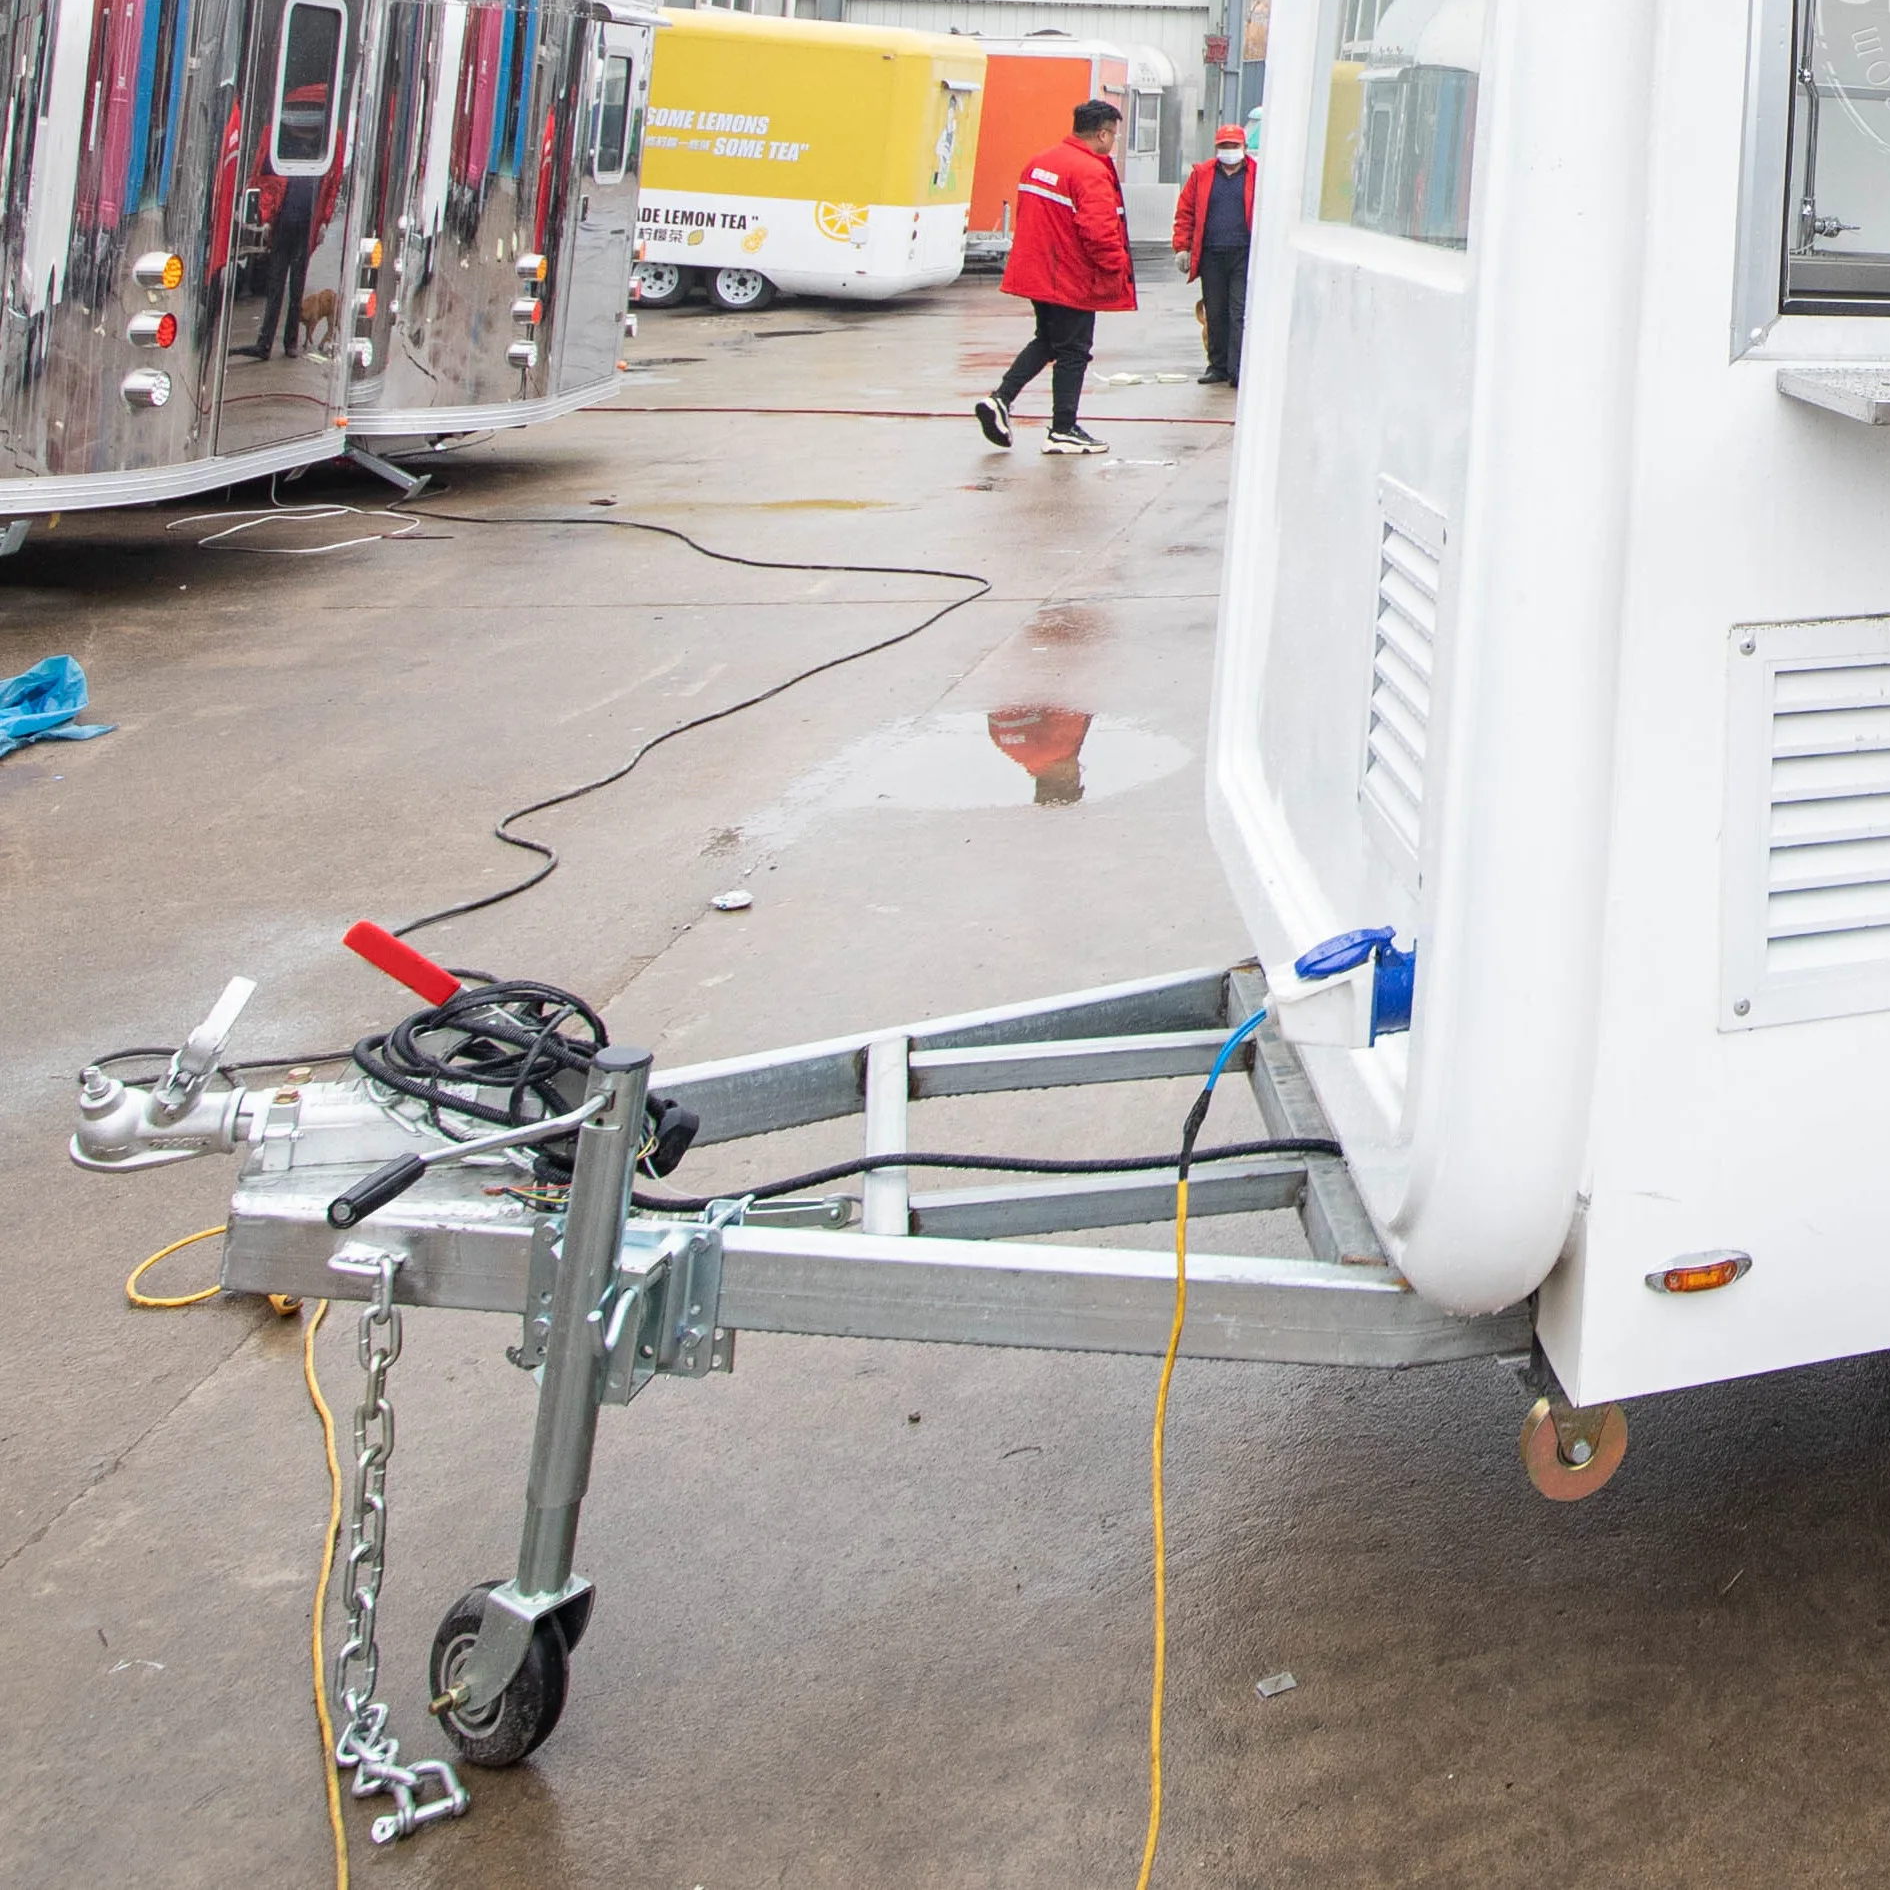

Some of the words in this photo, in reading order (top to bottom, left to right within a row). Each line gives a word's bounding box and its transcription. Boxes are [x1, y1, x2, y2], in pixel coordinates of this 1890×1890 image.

[646, 107, 696, 129] SOME
[696, 111, 770, 135] LEMONS
[713, 137, 765, 159] SOME
[664, 209, 716, 228] LEMON
